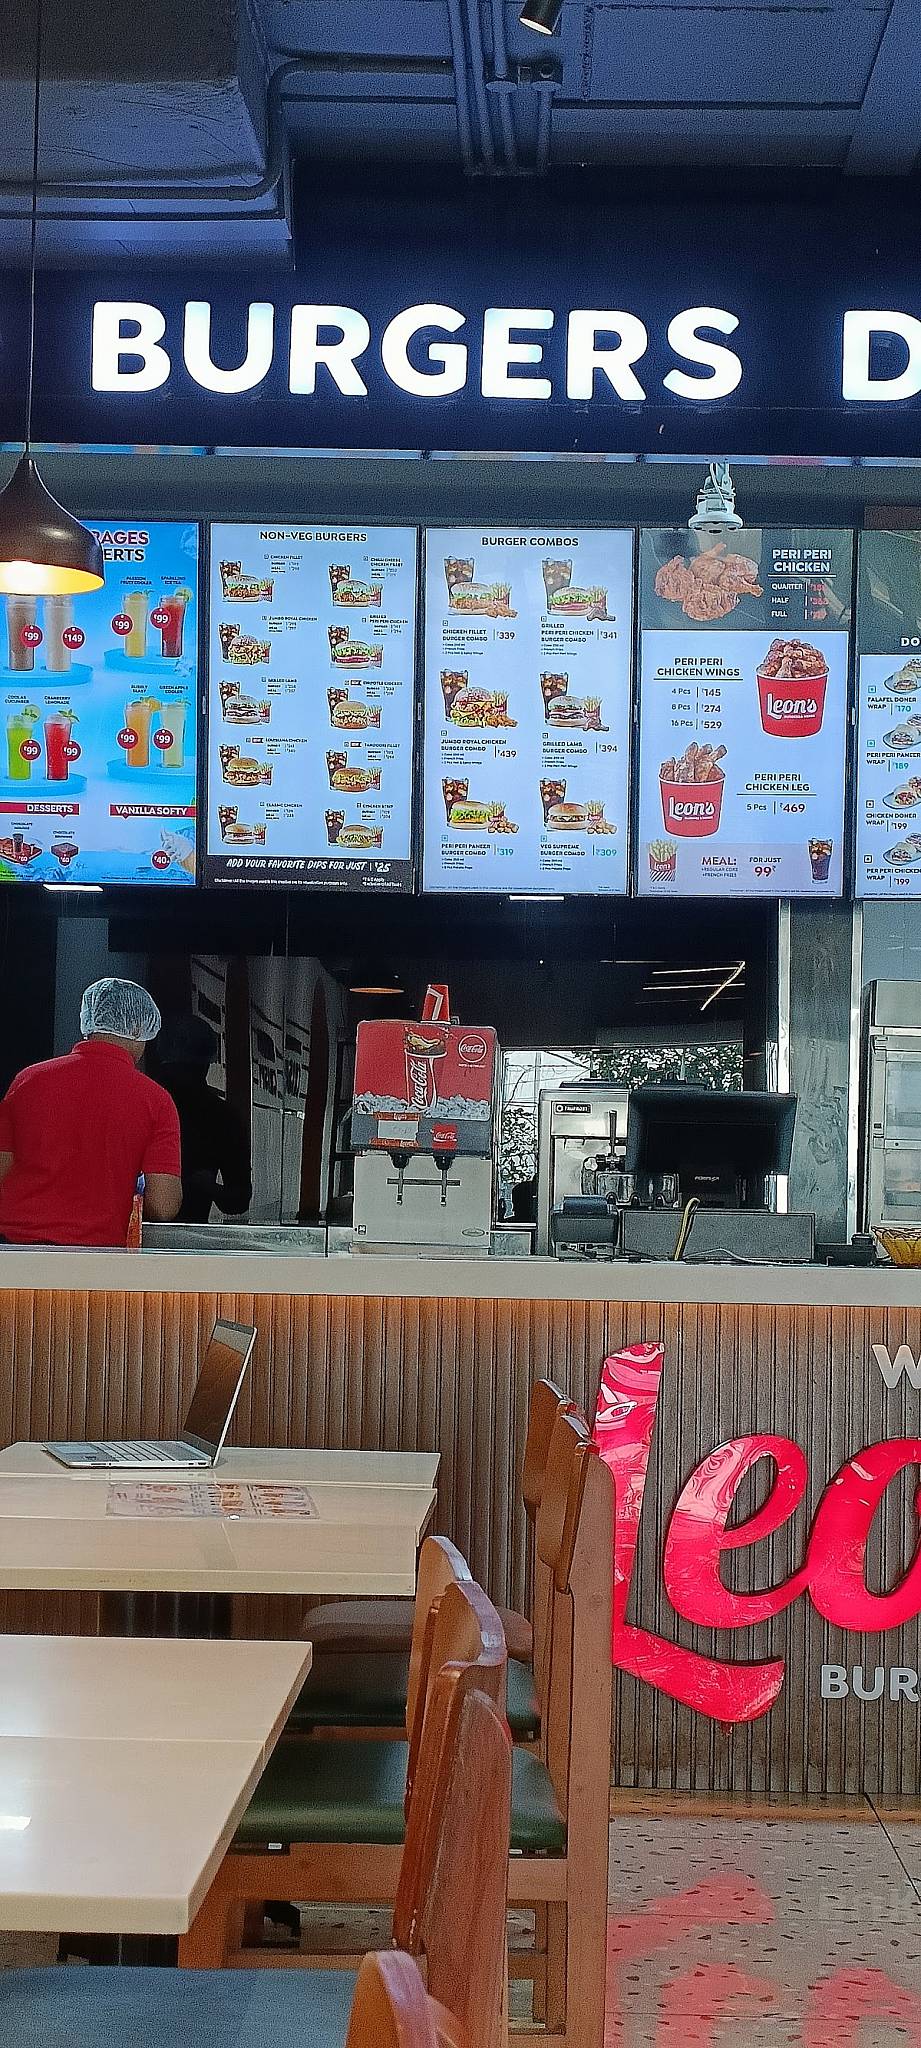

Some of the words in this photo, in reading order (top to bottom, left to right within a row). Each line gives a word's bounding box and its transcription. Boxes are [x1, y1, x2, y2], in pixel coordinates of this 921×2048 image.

[91, 300, 743, 402] BURGERS
[842, 310, 921, 402] D
[260, 531, 313, 541] NON-VEG
[315, 532, 367, 542] BURGERS
[481, 537, 527, 547] BURGER
[529, 537, 579, 547] COMBOS
[772, 549, 801, 560] PERI
[803, 549, 832, 560] PERI
[773, 561, 830, 572] CHICKEN
[674, 657, 698, 666] PERI
[699, 658, 723, 666] PERI
[657, 667, 703, 676] CHICKEN
[705, 668, 740, 676] WINGS
[678, 687, 691, 695] Pcs
[677, 703, 691, 711] Pcs
[767, 693, 818, 720] Leon's
[671, 719, 679, 727] 16
[680, 719, 694, 727] Pcs
[754, 773, 777, 781] PERI
[778, 773, 801, 782] PERI
[745, 783, 789, 791] CHICKEN
[791, 783, 810, 792] LEG
[26, 804, 74, 813] DESSERTS
[115, 805, 156, 815] VANILLA
[157, 806, 187, 816] SOFTY
[669, 796, 715, 821] Leon's
[746, 803, 752, 811] 5
[753, 803, 767, 811] Pcs
[226, 858, 244, 868] ADD
[244, 858, 267, 869] YOUR
[267, 859, 306, 870] FAVORITE
[307, 860, 328, 870] DIPS
[328, 860, 345, 870] FOR
[345, 861, 368, 871] JUST
[701, 856, 737, 866] MEAL:
[820, 1663, 921, 1703] BUR
